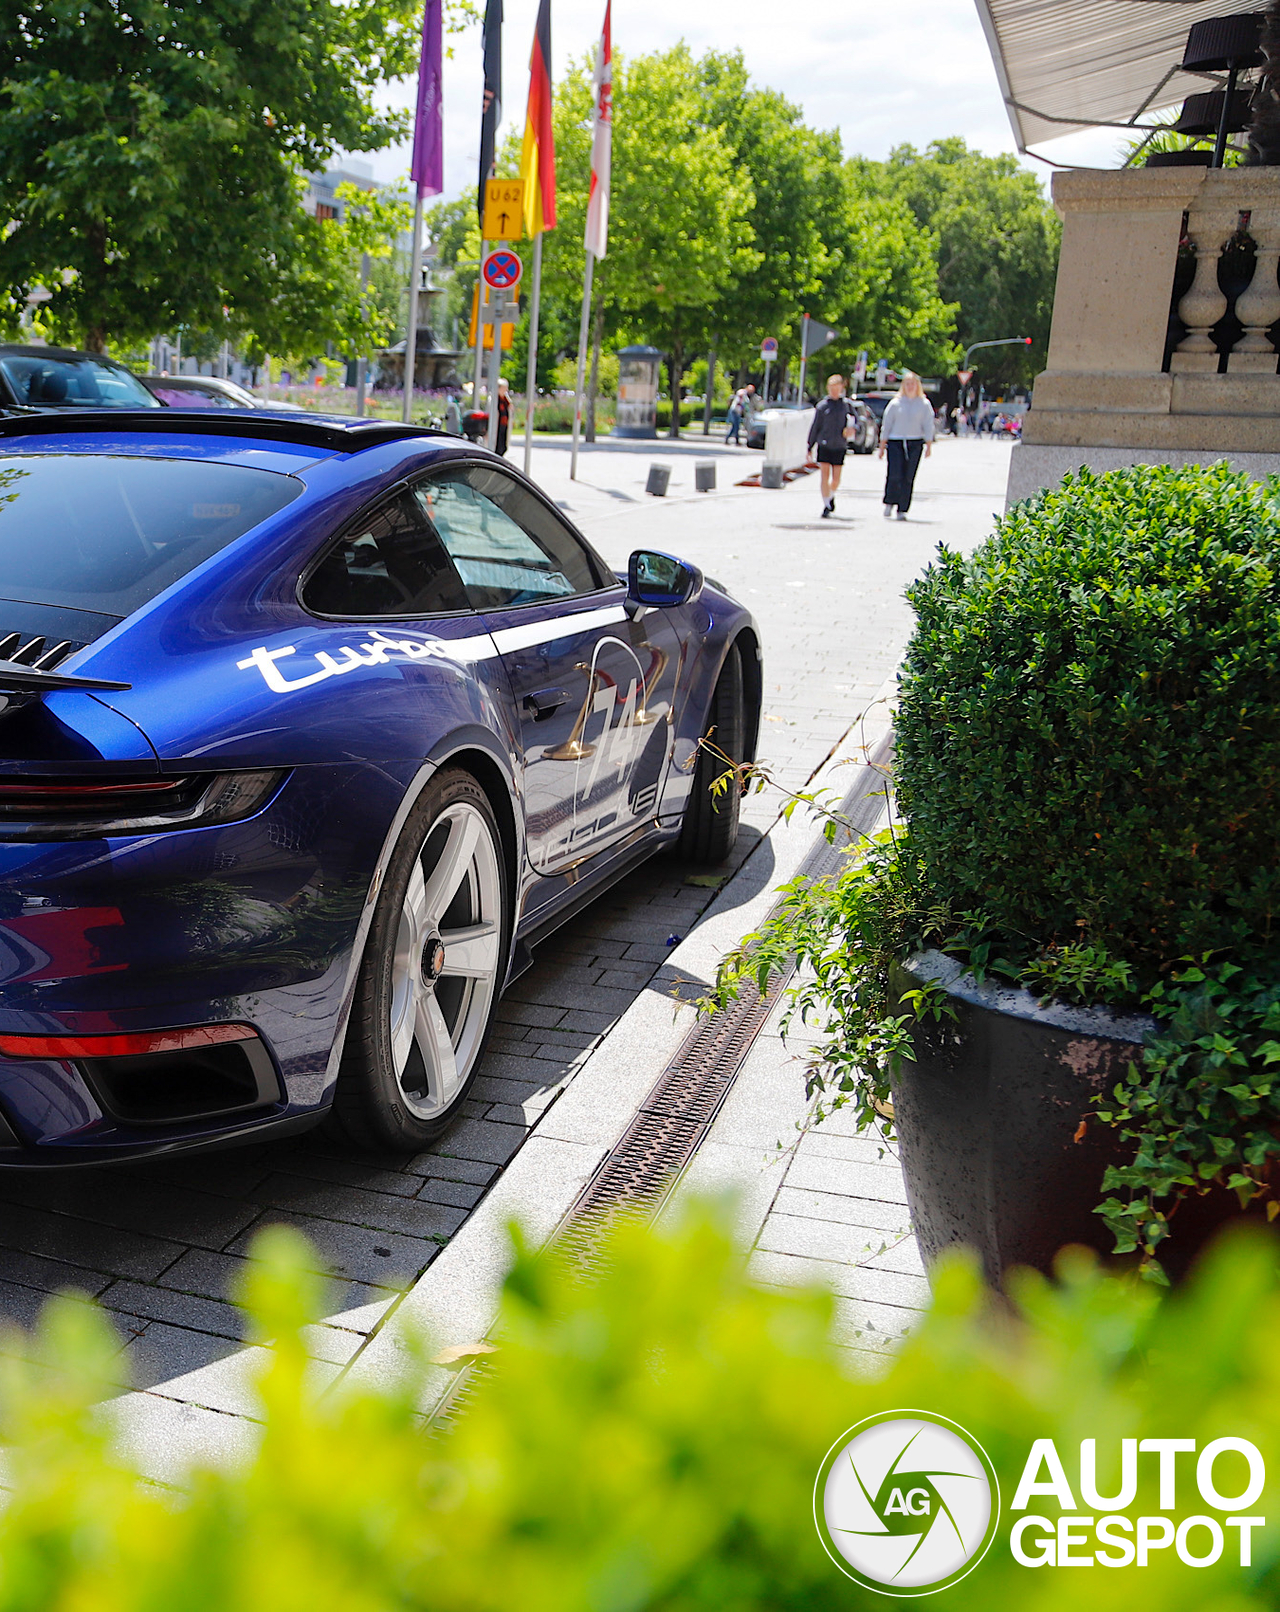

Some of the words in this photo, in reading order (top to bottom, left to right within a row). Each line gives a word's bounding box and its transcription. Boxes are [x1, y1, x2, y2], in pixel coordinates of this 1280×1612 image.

[490, 188, 500, 201] U
[504, 188, 520, 203] 62
[236, 631, 454, 694] turbo
[582, 677, 637, 801] 74
